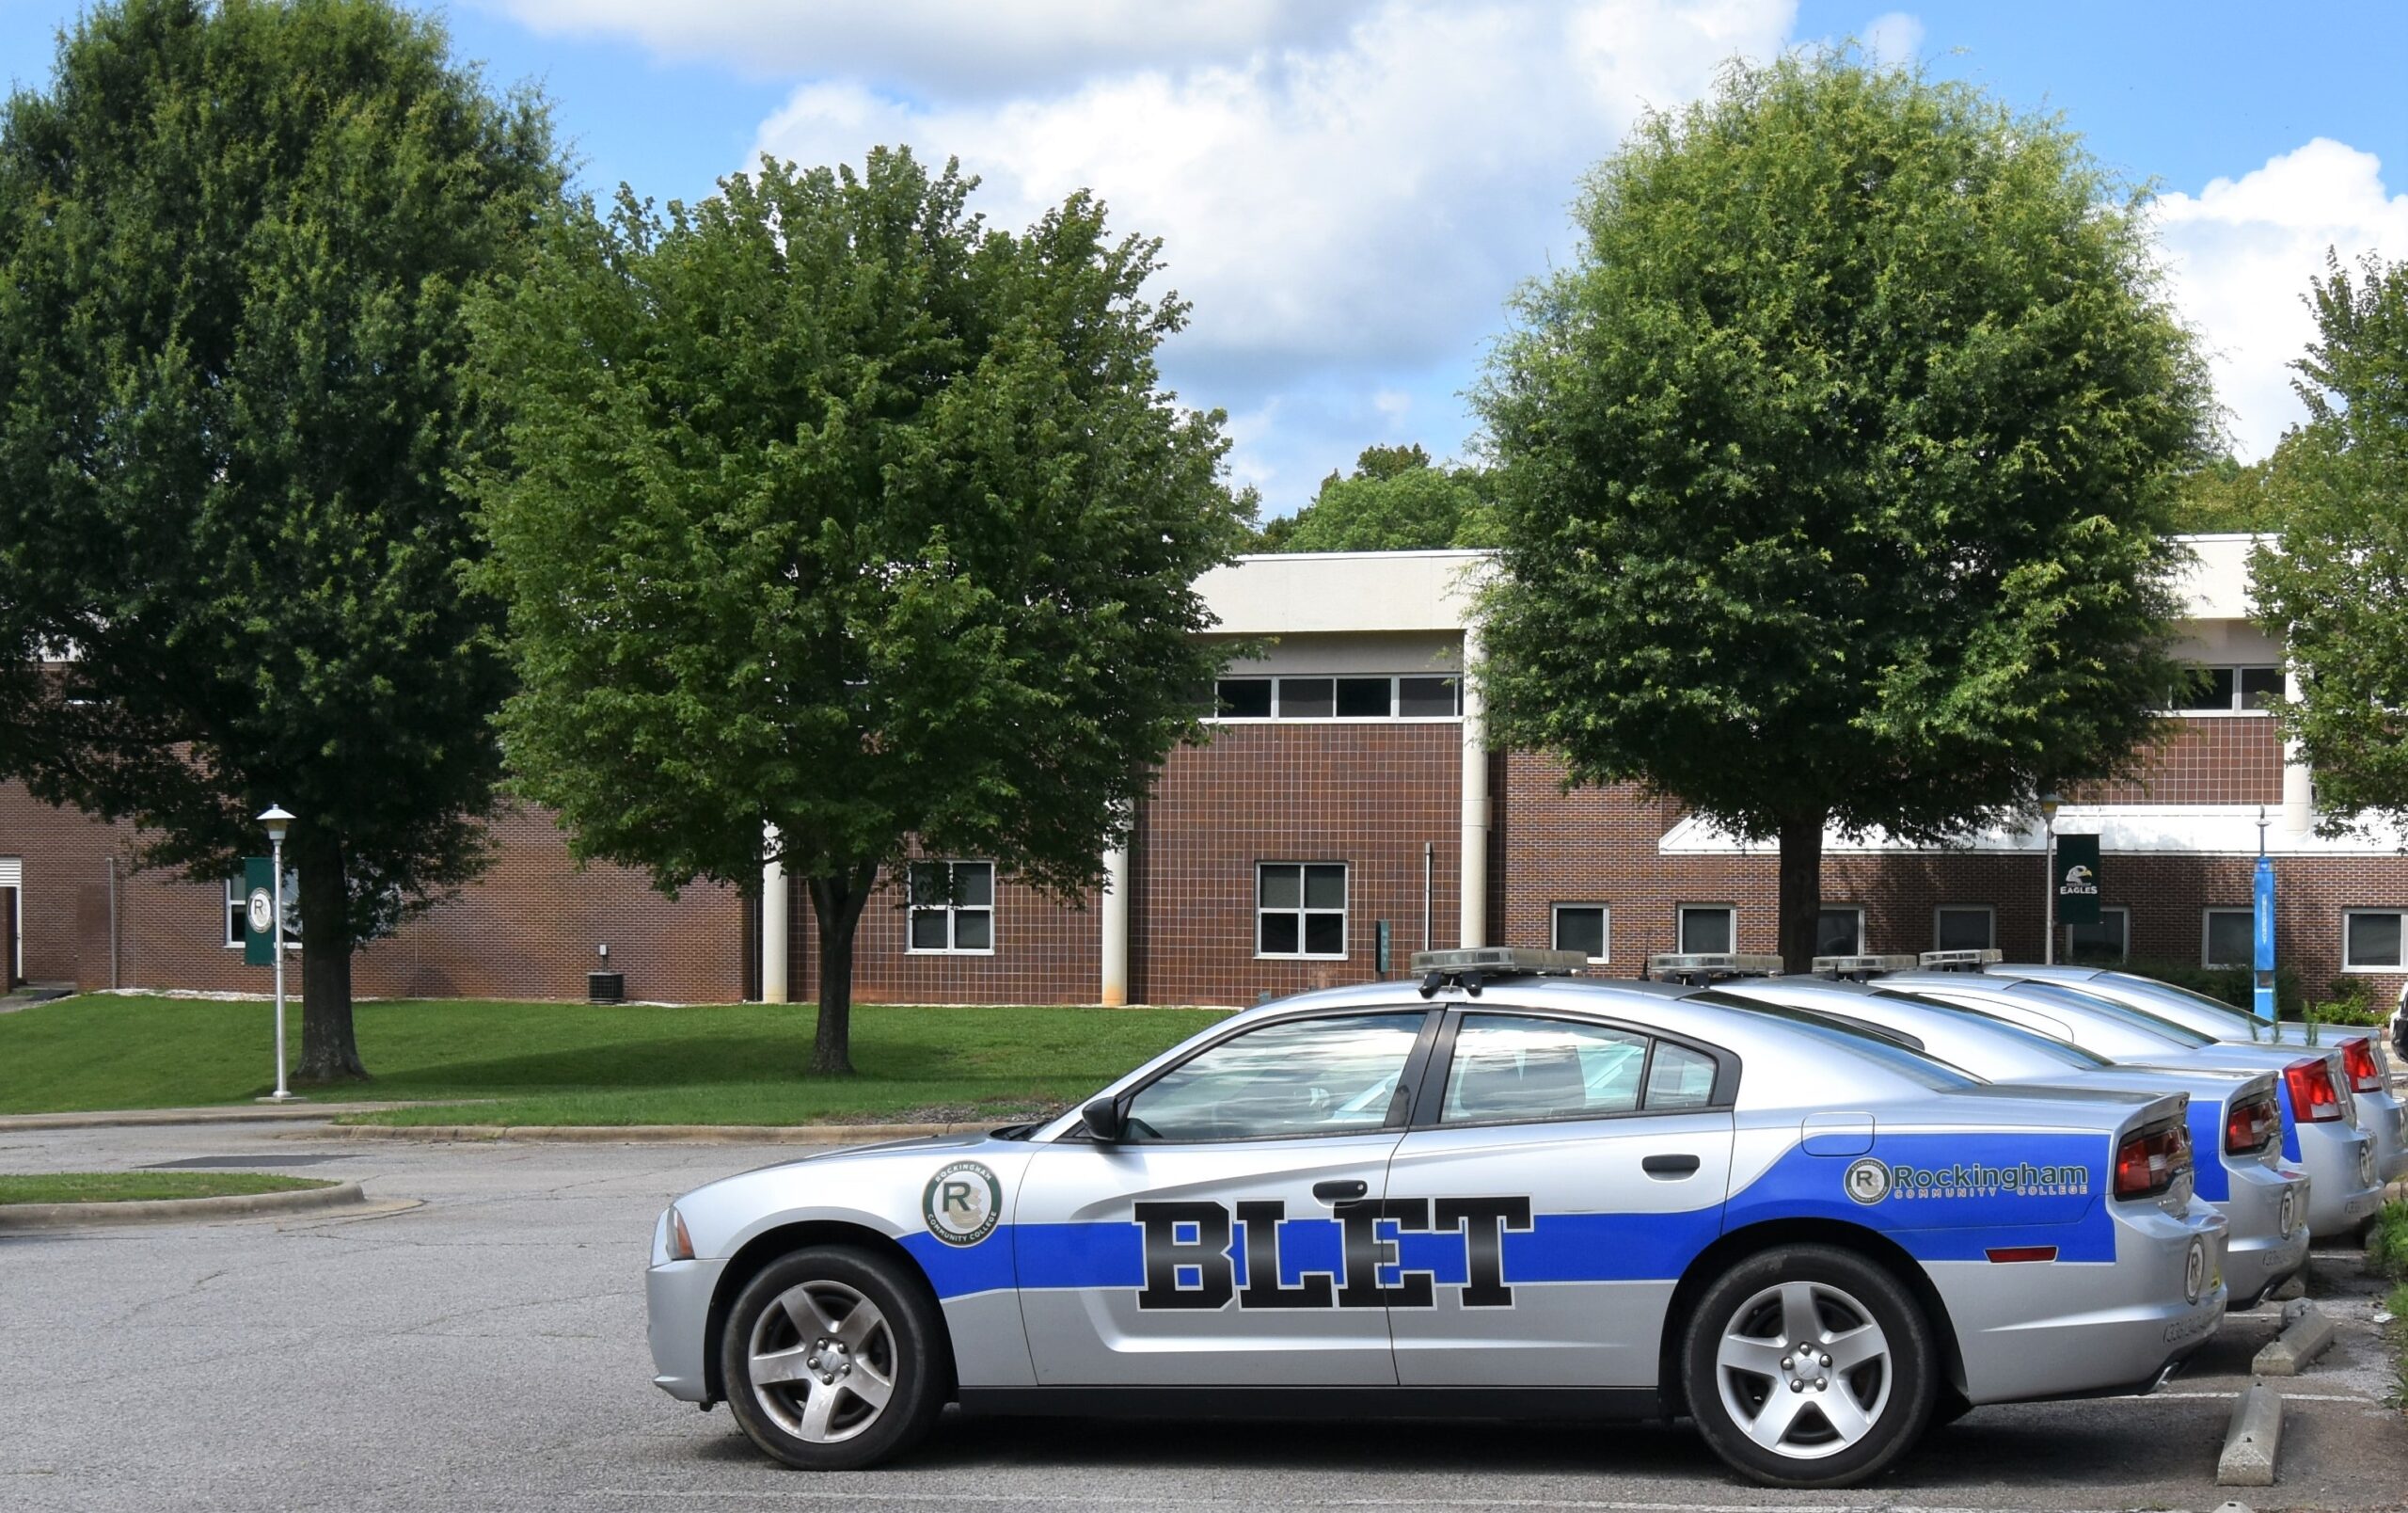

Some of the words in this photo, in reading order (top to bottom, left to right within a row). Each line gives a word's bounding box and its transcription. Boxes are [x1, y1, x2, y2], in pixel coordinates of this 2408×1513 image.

[2060, 885, 2098, 895] EAGLES
[254, 899, 263, 915] R
[935, 1163, 991, 1183] ROCKINGHAM
[1856, 1170, 1873, 1187] R
[1893, 1162, 2088, 1191] Rockingham
[943, 1182, 971, 1212] R
[1894, 1187, 1997, 1200] COMMUNITY
[2017, 1185, 2088, 1196] COLLEGE
[927, 1213, 967, 1242] COMMUNITY
[969, 1211, 997, 1240] COLLEGE
[1133, 1195, 1533, 1312] BLET
